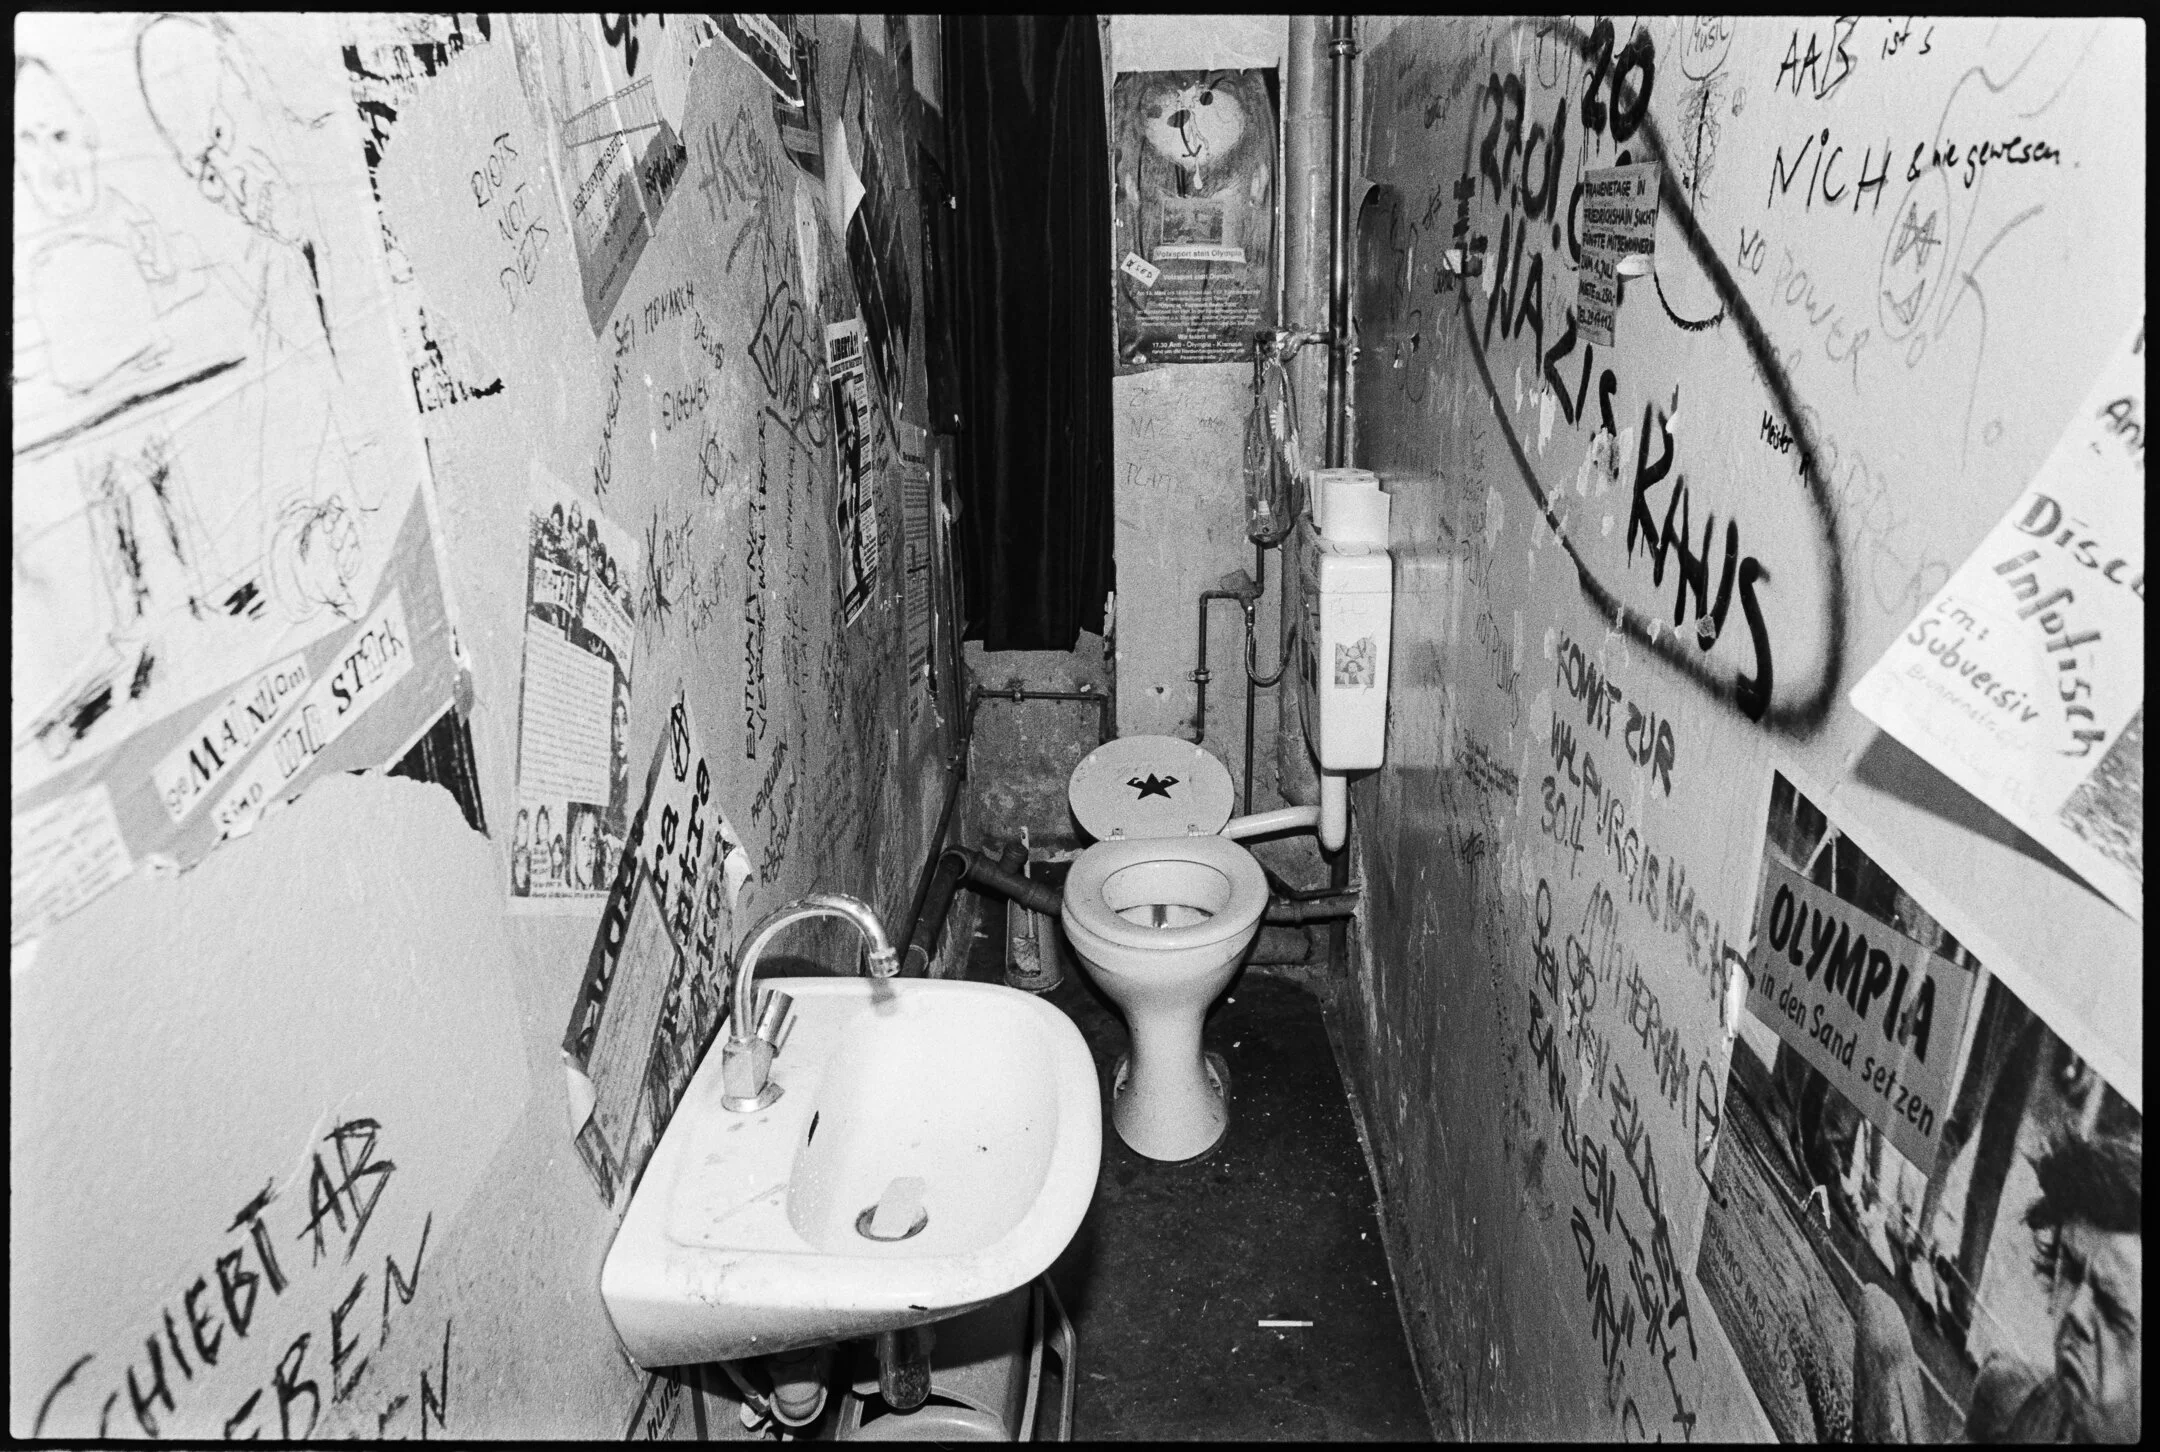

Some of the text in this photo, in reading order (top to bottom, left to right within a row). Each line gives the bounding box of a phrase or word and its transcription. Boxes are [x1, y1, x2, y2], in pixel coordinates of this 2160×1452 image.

[1738, 226, 1767, 275] NO
[1627, 401, 1772, 724] RAUS
[1759, 970, 1936, 1138] in den Sand setzen
[1767, 881, 1938, 1065] OLYMPIA
[297, 1115, 397, 1268] AB
